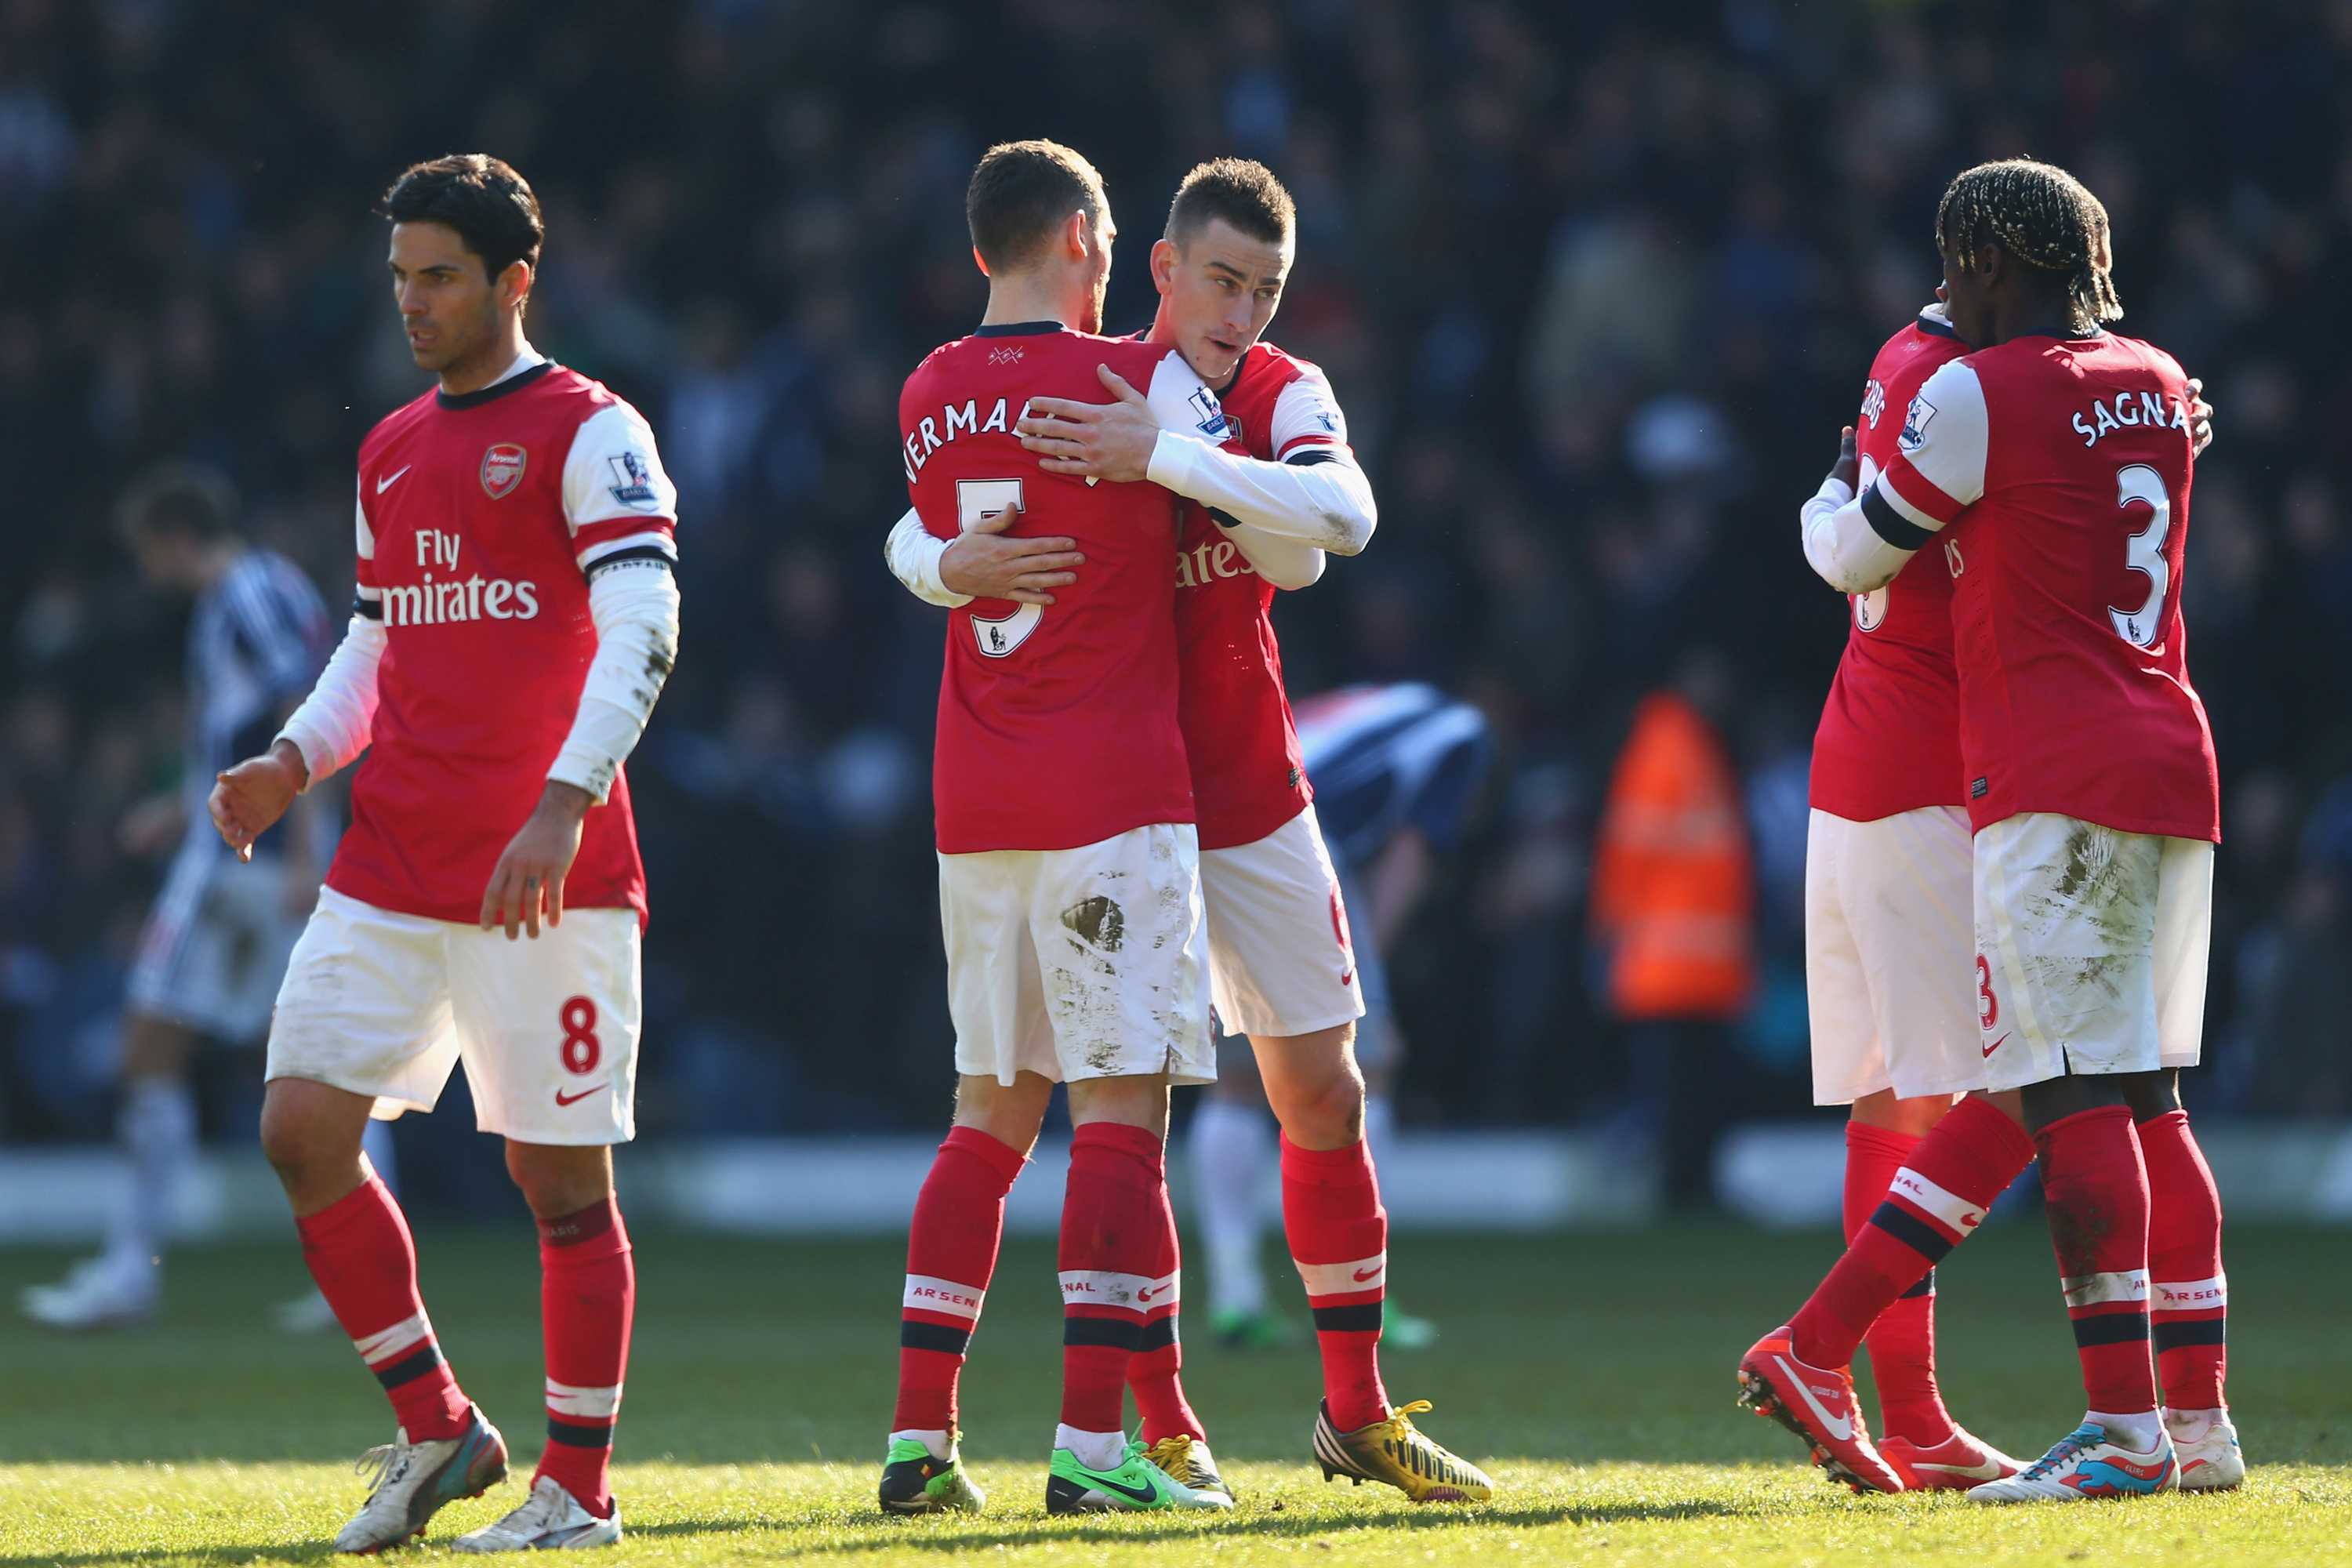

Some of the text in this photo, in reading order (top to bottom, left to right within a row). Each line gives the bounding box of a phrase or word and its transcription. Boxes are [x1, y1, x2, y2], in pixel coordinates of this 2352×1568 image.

[2072, 391, 2190, 448] SAGNA
[416, 528, 460, 572] Fly
[2109, 463, 2170, 648] 3
[381, 572, 539, 627] mirates
[558, 994, 600, 1076] 8
[914, 1287, 978, 1308] ARSEN
[2163, 1288, 2222, 1300] ARSEN
